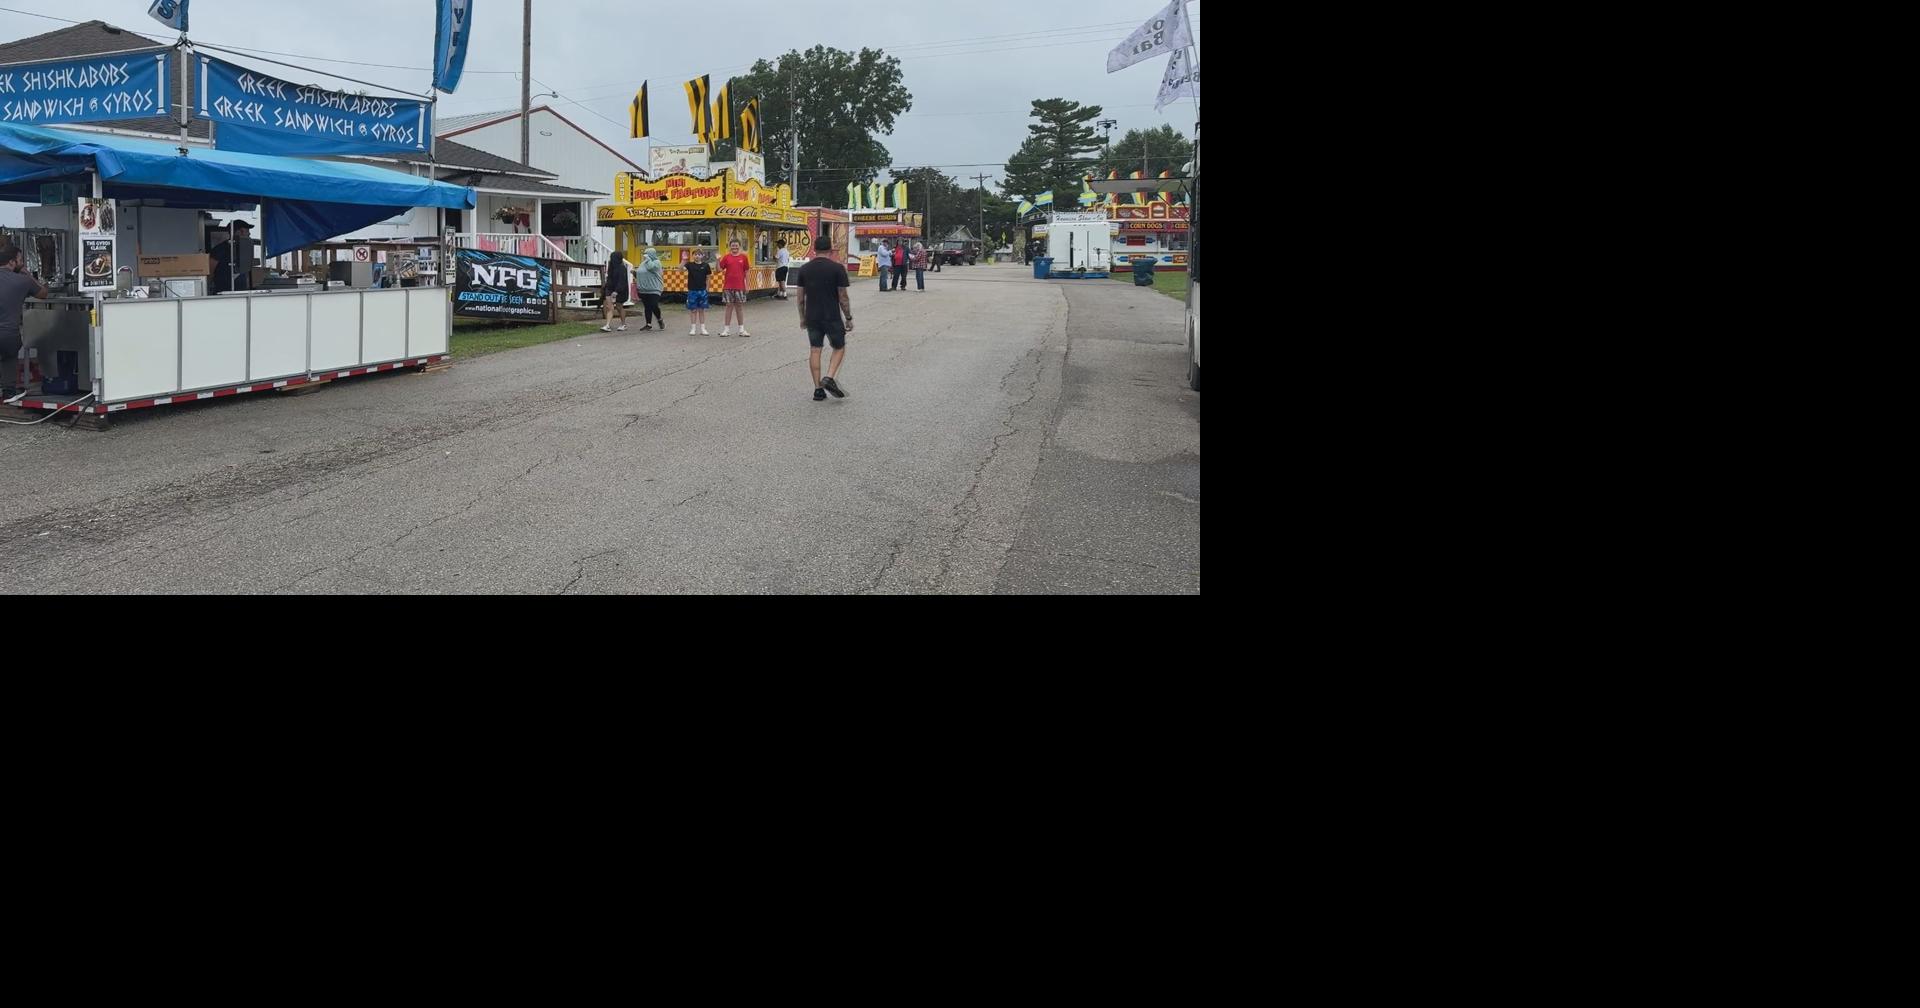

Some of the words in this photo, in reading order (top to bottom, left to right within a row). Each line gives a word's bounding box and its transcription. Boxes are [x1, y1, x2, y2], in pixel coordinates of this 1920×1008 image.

[22, 62, 130, 93] SHISHKABOBS
[3, 96, 84, 121] SANDWICH
[102, 88, 153, 112] GYROS
[237, 72, 287, 100] GREEK
[295, 86, 398, 119] SHISHKABOBS
[213, 96, 267, 125] GREEK
[274, 107, 354, 137] SANDWICH
[371, 125, 414, 145] GYROS
[671, 186, 720, 200] FACTORY
[471, 264, 538, 290] NFG
[461, 292, 484, 301] STAND
[484, 293, 499, 302] OUT
